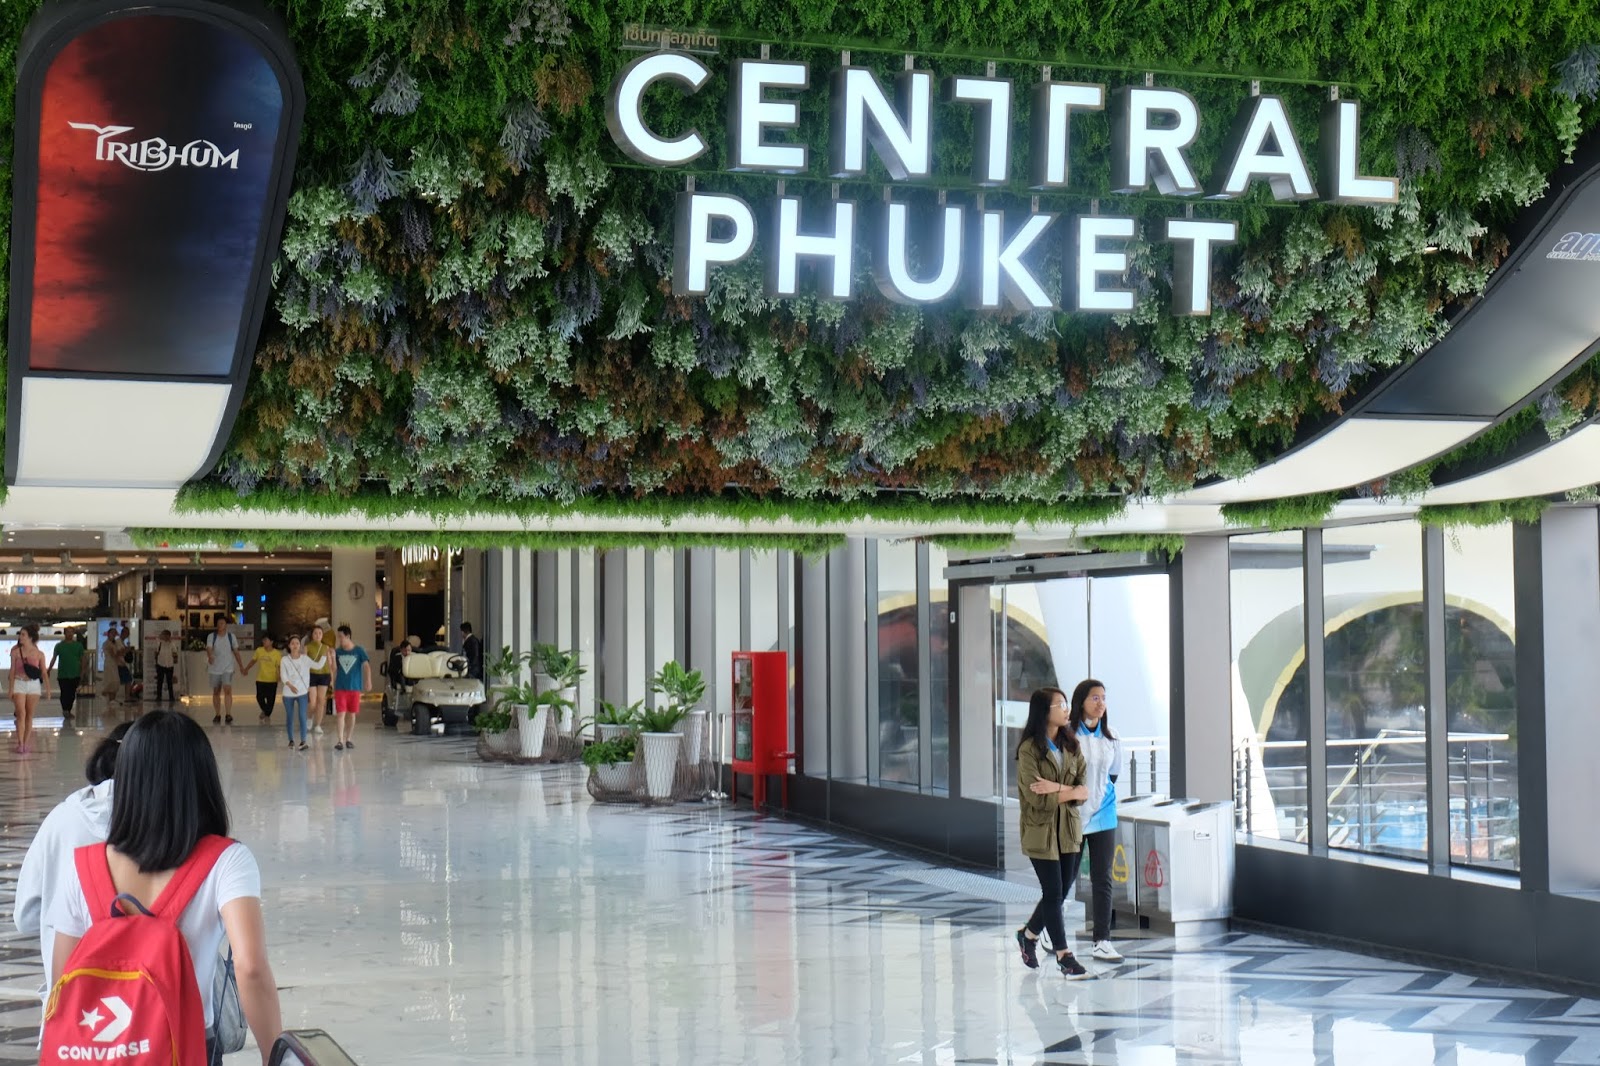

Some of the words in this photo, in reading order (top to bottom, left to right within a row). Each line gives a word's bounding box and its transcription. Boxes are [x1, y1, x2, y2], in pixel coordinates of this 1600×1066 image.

[67, 121, 240, 172] TRIBHUM
[610, 51, 1400, 205] CENTRAL
[682, 190, 1238, 317] PHUKET
[57, 1038, 150, 1061] CONVERSE
